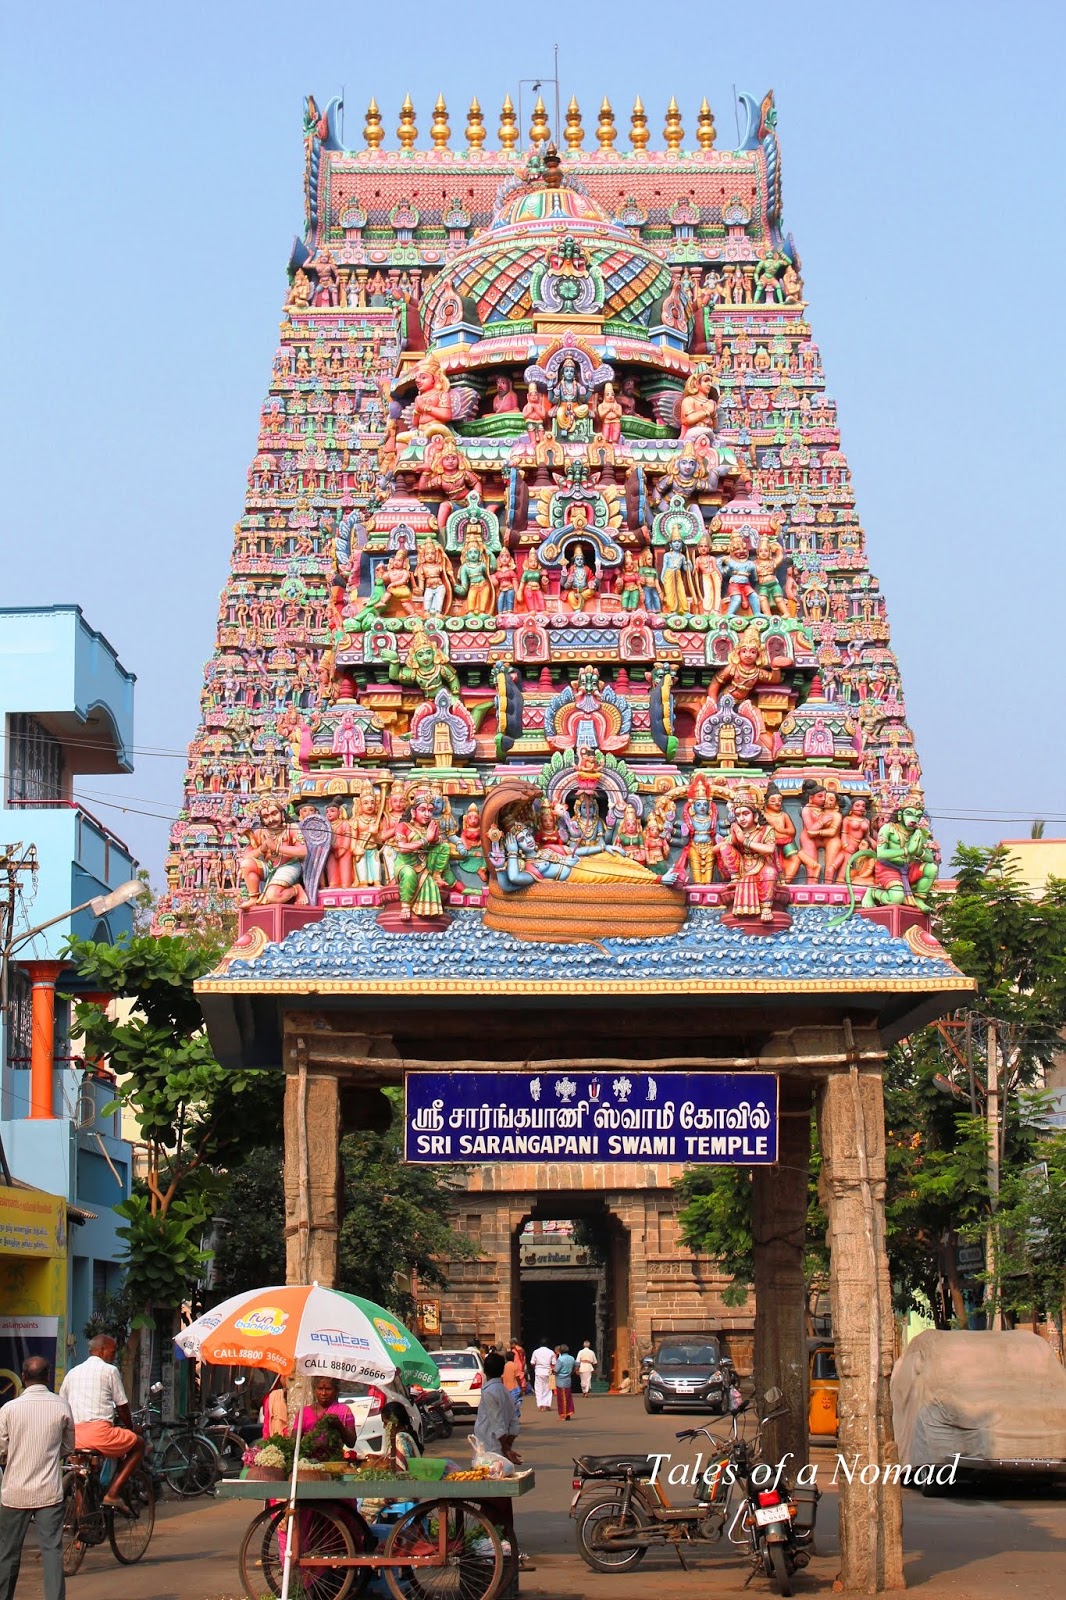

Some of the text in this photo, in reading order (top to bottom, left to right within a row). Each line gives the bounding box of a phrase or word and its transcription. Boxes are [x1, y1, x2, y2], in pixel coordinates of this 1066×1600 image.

[449, 1100, 589, 1131] சார்ங்கபாணி
[593, 1101, 675, 1129] ஸ்வாமி
[680, 1101, 770, 1129] கோவில்
[417, 1135, 768, 1155] SRI SARANGAPANI SWAMI TEMPLE
[248, 1313, 274, 1324] fun
[1, 1322, 38, 1331] asianpaints
[310, 1333, 370, 1347] equitas
[213, 1349, 238, 1359] CALL
[304, 1359, 386, 1380] CALL 88800 36666
